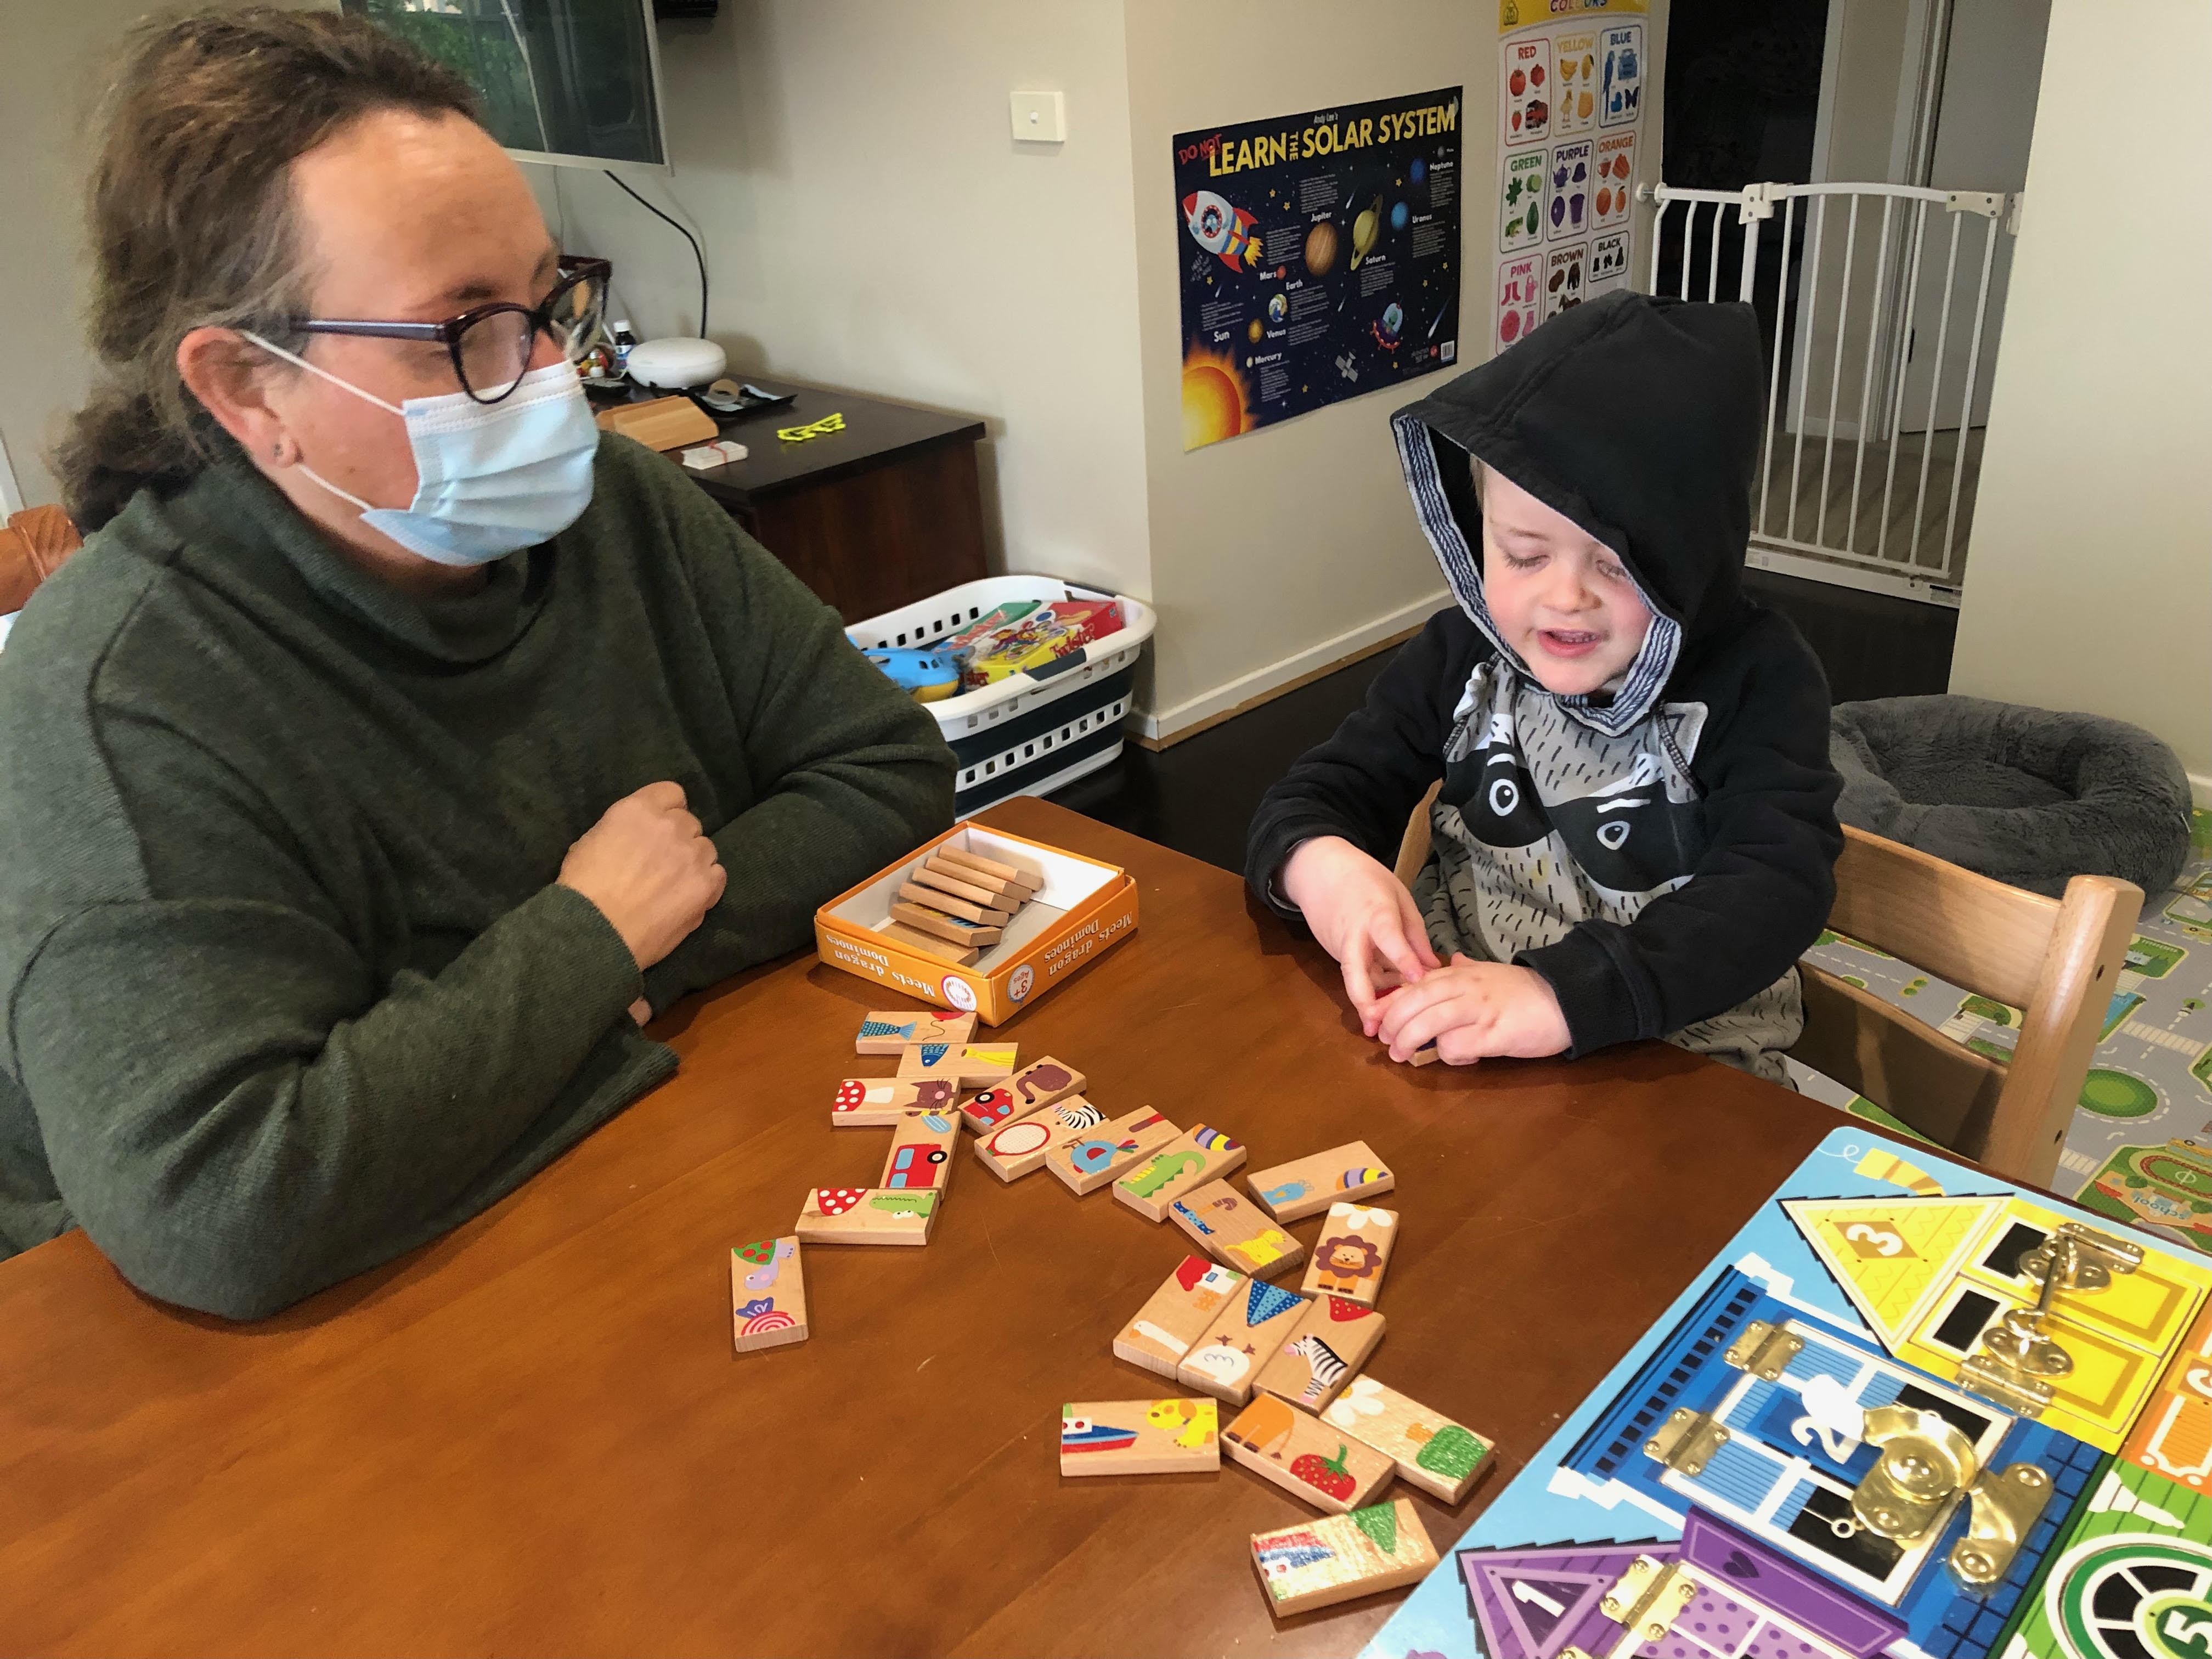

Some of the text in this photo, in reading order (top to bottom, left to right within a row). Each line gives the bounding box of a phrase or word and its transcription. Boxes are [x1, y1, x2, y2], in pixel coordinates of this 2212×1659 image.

[1557, 37, 1593, 53] YELLOW
[1610, 31, 1632, 46] BLUE
[1518, 46, 1536, 60] RED
[1178, 103, 1454, 177] DO NOT LEARN THE SOLAR SYSTEM
[1599, 136, 1633, 153] ORANGE
[1556, 145, 1589, 163] PURPLE
[1430, 161, 1454, 171] Neptune
[1510, 155, 1542, 172] GREEN
[1311, 211, 1332, 222] Jupiter
[1412, 214, 1432, 223] Uranus
[1598, 238, 1621, 252] BLACK
[1365, 255, 1386, 265] Saturn
[1551, 248, 1584, 267] BROWN
[1260, 272, 1277, 281] Mars
[1510, 262, 1532, 278] PINK
[1286, 279, 1303, 290] Earth
[1214, 330, 1230, 342] Sun
[1267, 329, 1286, 338] Venus
[1255, 352, 1282, 364] Mercury
[1049, 624, 1094, 657] Twister
[1043, 919, 1099, 963] Dominoes
[1048, 910, 1132, 977] Meets dragon
[826, 935, 889, 967] Dominoes
[834, 950, 935, 997] Meets dragon
[1013, 969, 1030, 985] Ages
[1014, 979, 1028, 997] 3+
[1846, 1223, 1903, 1255] 3
[1791, 1416, 1861, 1464] 2
[1512, 1580, 1566, 1617] 1
[2164, 1610, 2212, 1656] 5
